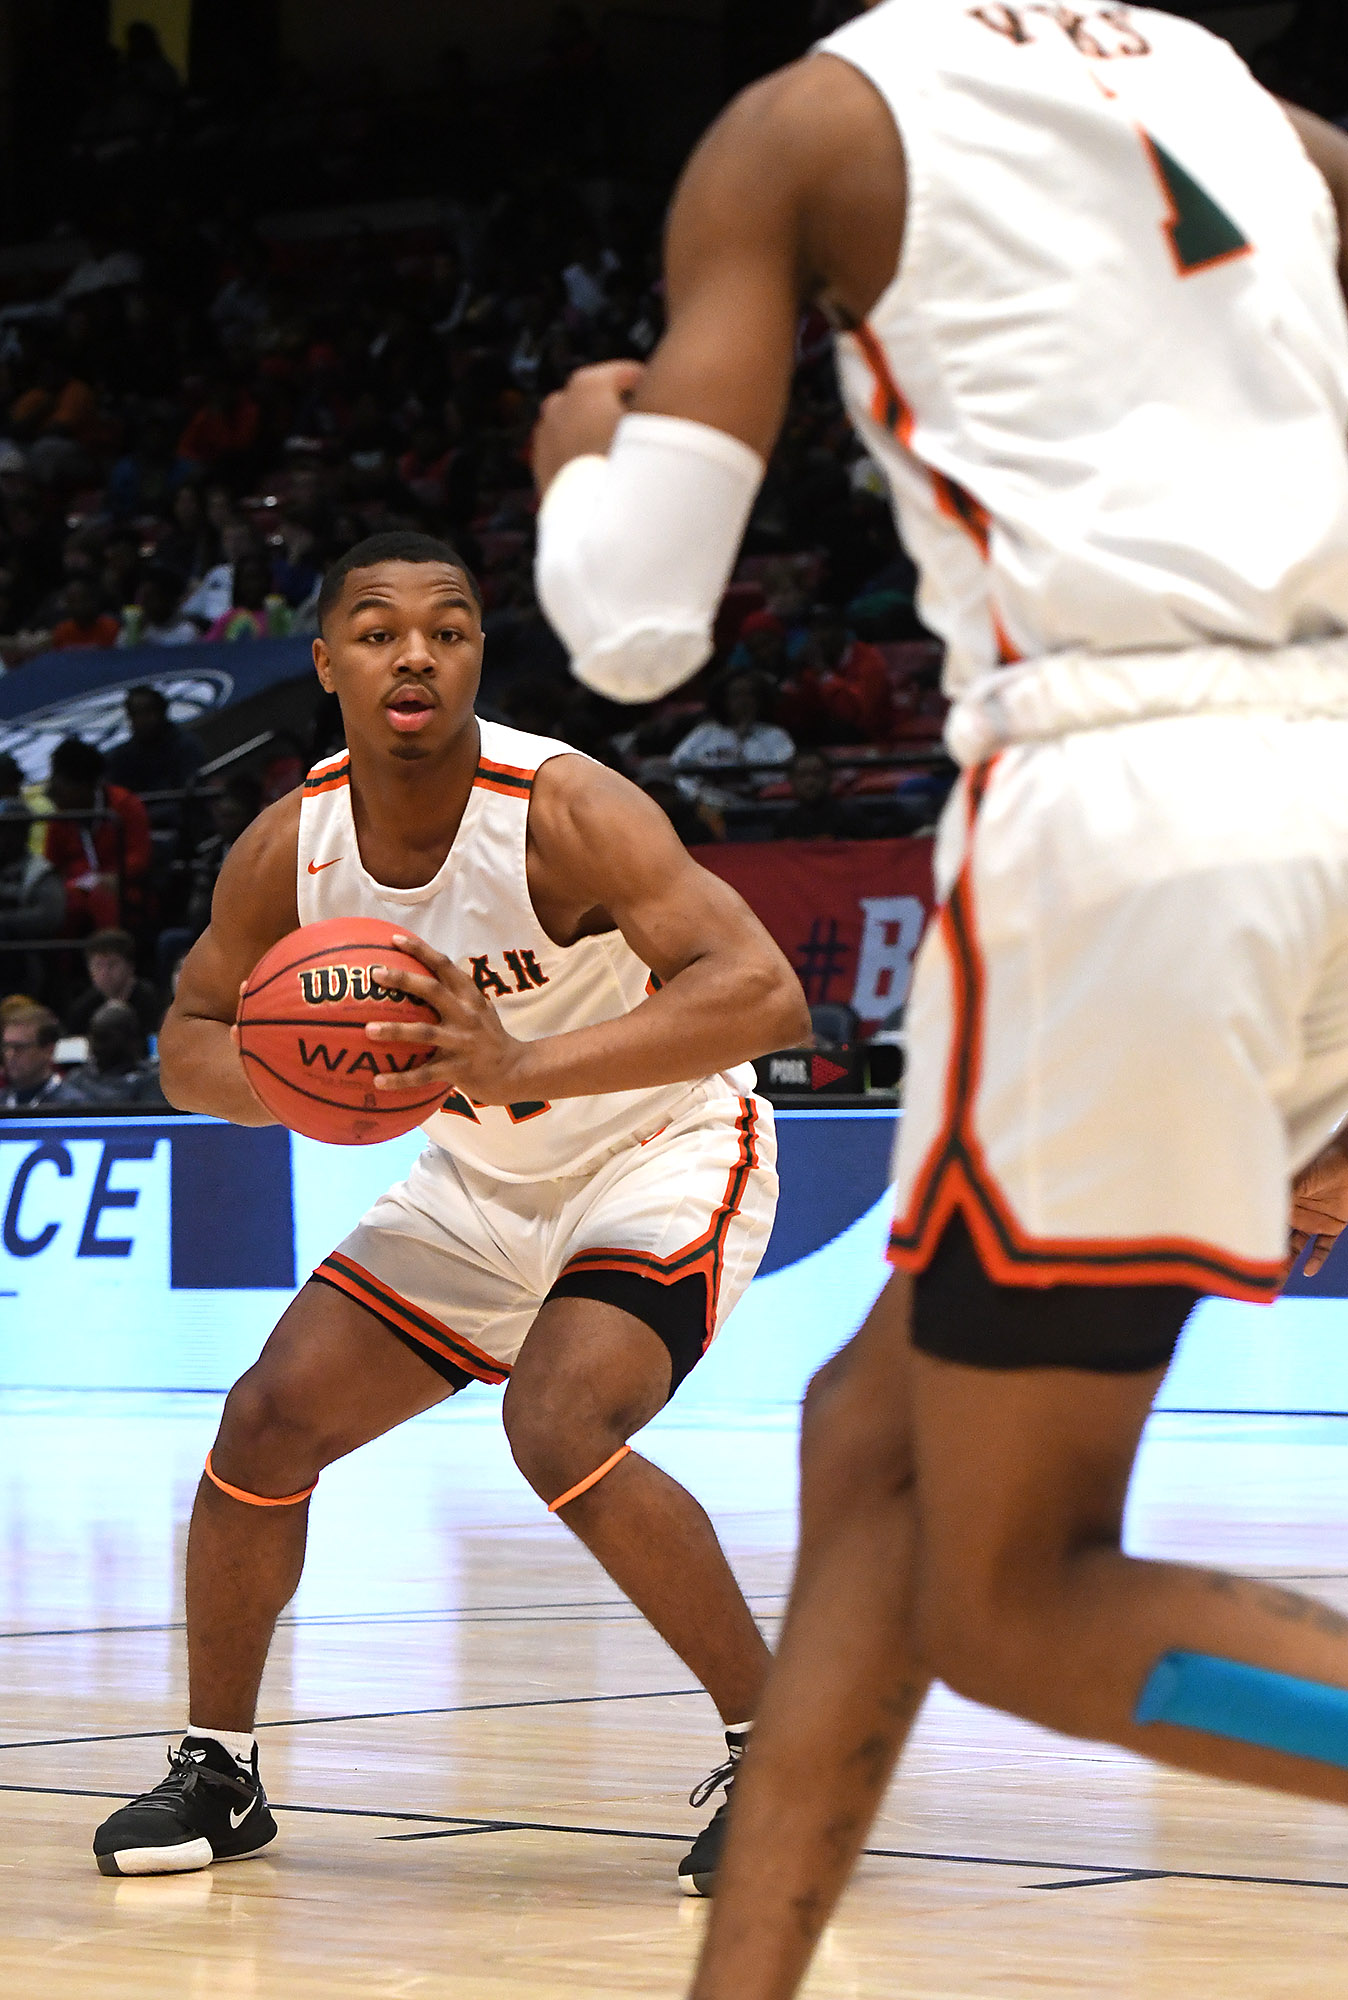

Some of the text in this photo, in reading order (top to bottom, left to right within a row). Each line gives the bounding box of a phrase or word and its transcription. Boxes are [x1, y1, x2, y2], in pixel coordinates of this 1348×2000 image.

[469, 949, 549, 999] AN
[298, 1038, 437, 1076] WAV
[3, 1138, 157, 1258] CE
